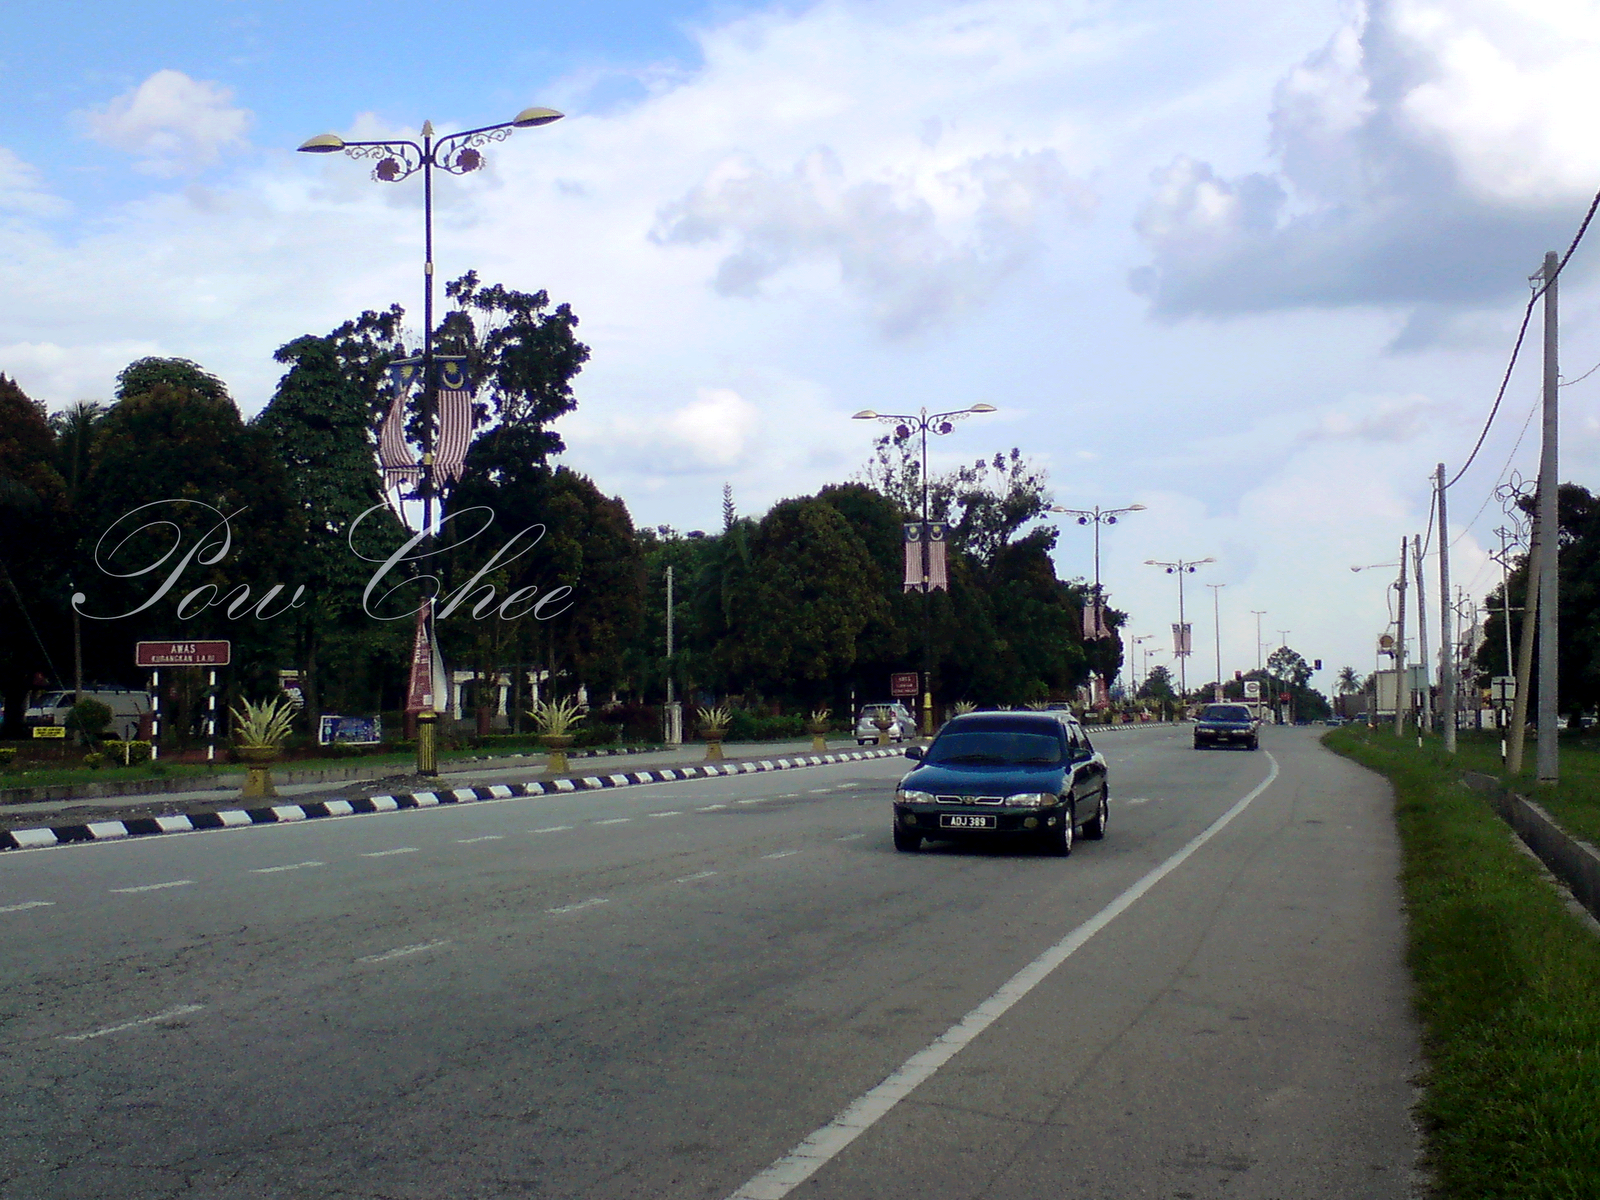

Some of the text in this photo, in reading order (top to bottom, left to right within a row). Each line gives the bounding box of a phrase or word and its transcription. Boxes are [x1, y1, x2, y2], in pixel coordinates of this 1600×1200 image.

[170, 644, 196, 654] AWAS
[950, 816, 986, 827] ADJ 389
